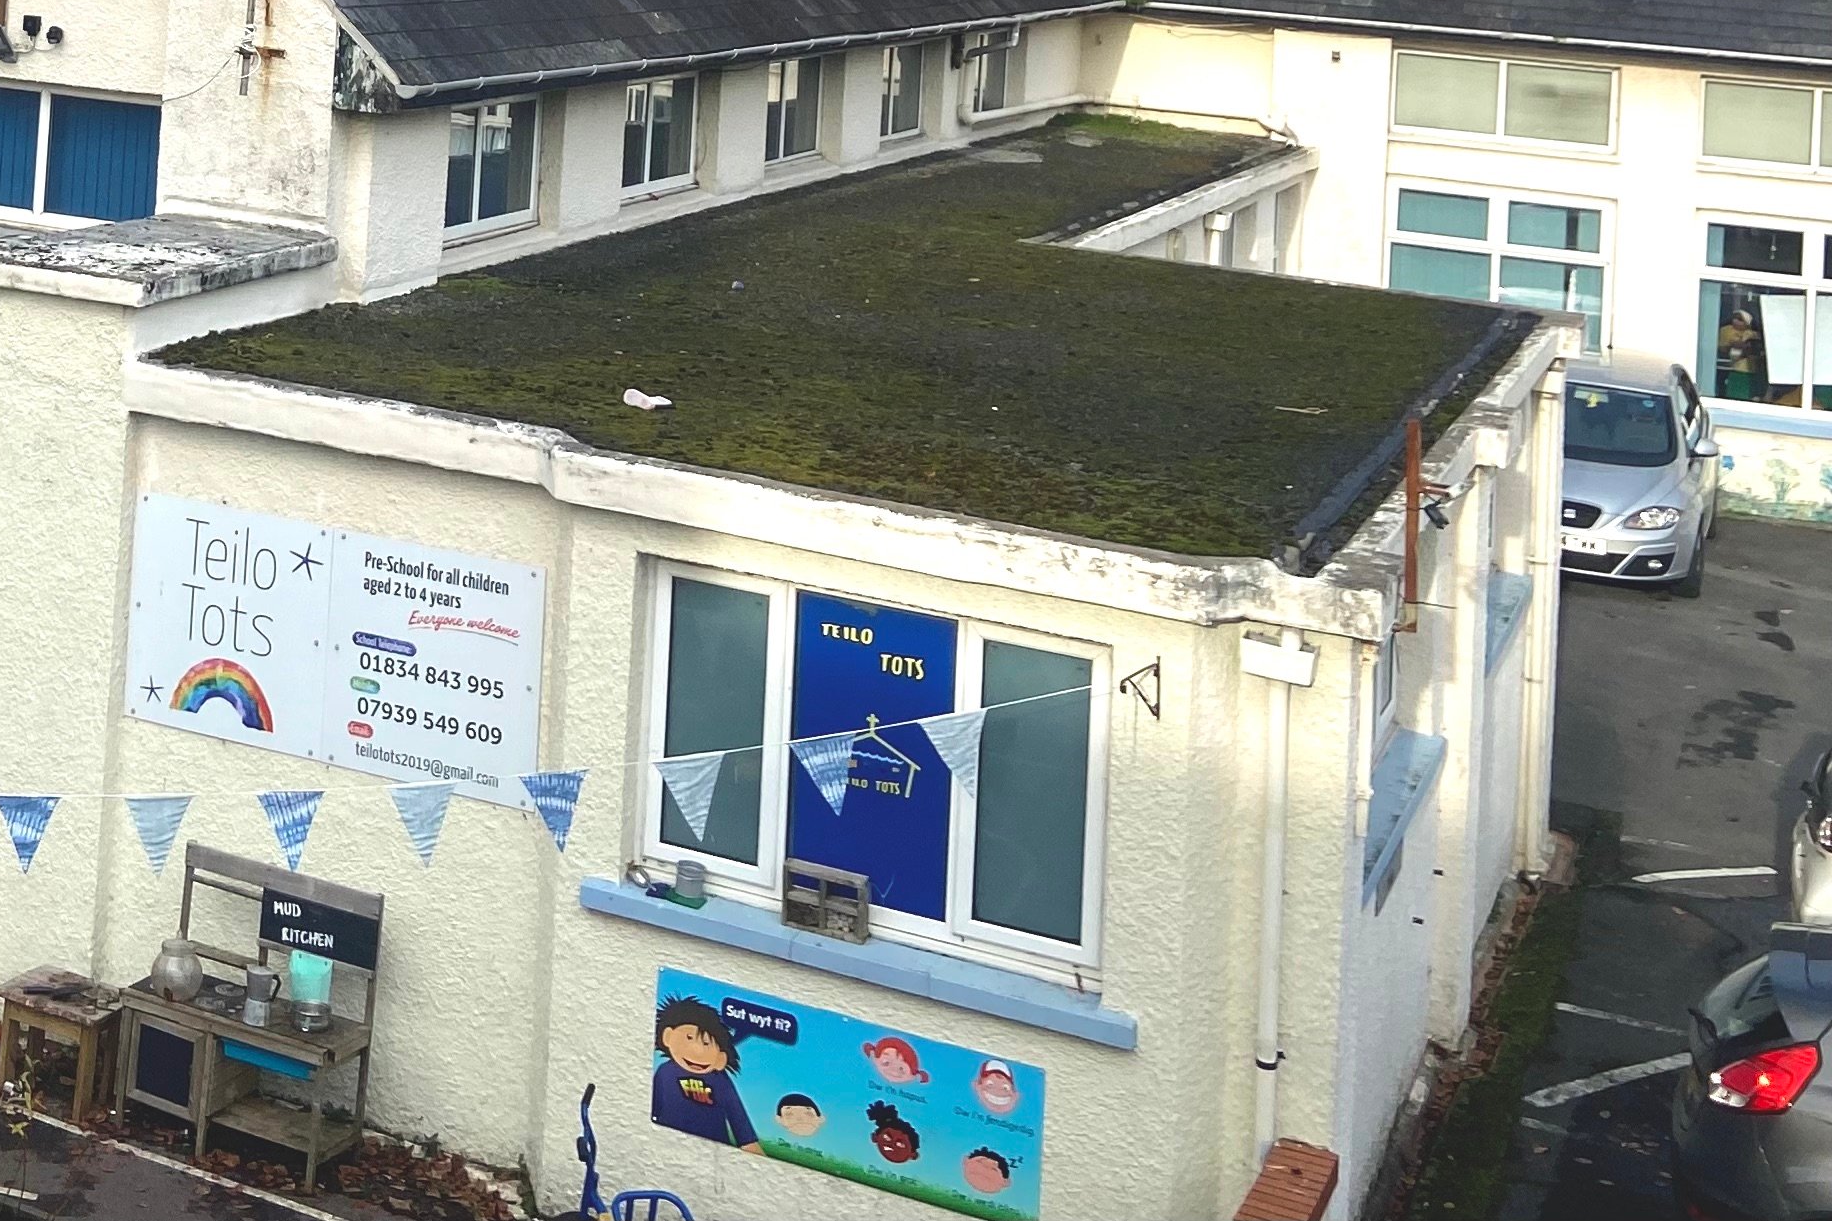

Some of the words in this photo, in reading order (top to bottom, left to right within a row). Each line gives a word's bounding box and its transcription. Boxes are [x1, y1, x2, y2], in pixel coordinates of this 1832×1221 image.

[186, 518, 277, 591] Teilo
[364, 551, 424, 579] Pre-School
[427, 563, 444, 583] for
[446, 568, 460, 586] all
[462, 570, 509, 596] children
[363, 577, 391, 595] aged
[393, 582, 402, 597] 2
[404, 582, 417, 600] to
[419, 587, 427, 602] 4
[429, 591, 462, 608] years
[181, 583, 274, 657] Tots
[408, 610, 465, 631] Everyone
[467, 618, 520, 638] welcome
[821, 623, 874, 645] TEILO
[360, 652, 420, 681] 01834
[425, 666, 461, 690] 843
[467, 675, 504, 699] 995
[880, 653, 925, 680] TOTS
[357, 697, 417, 726] 07939
[423, 711, 459, 735] 549
[466, 722, 502, 745] 609
[355, 741, 499, 788] teilotots2019@gmail.com
[875, 780, 900, 795] TOTS
[273, 901, 301, 918] MUD
[726, 1004, 746, 1020] Sut
[749, 1013, 772, 1029] wyt
